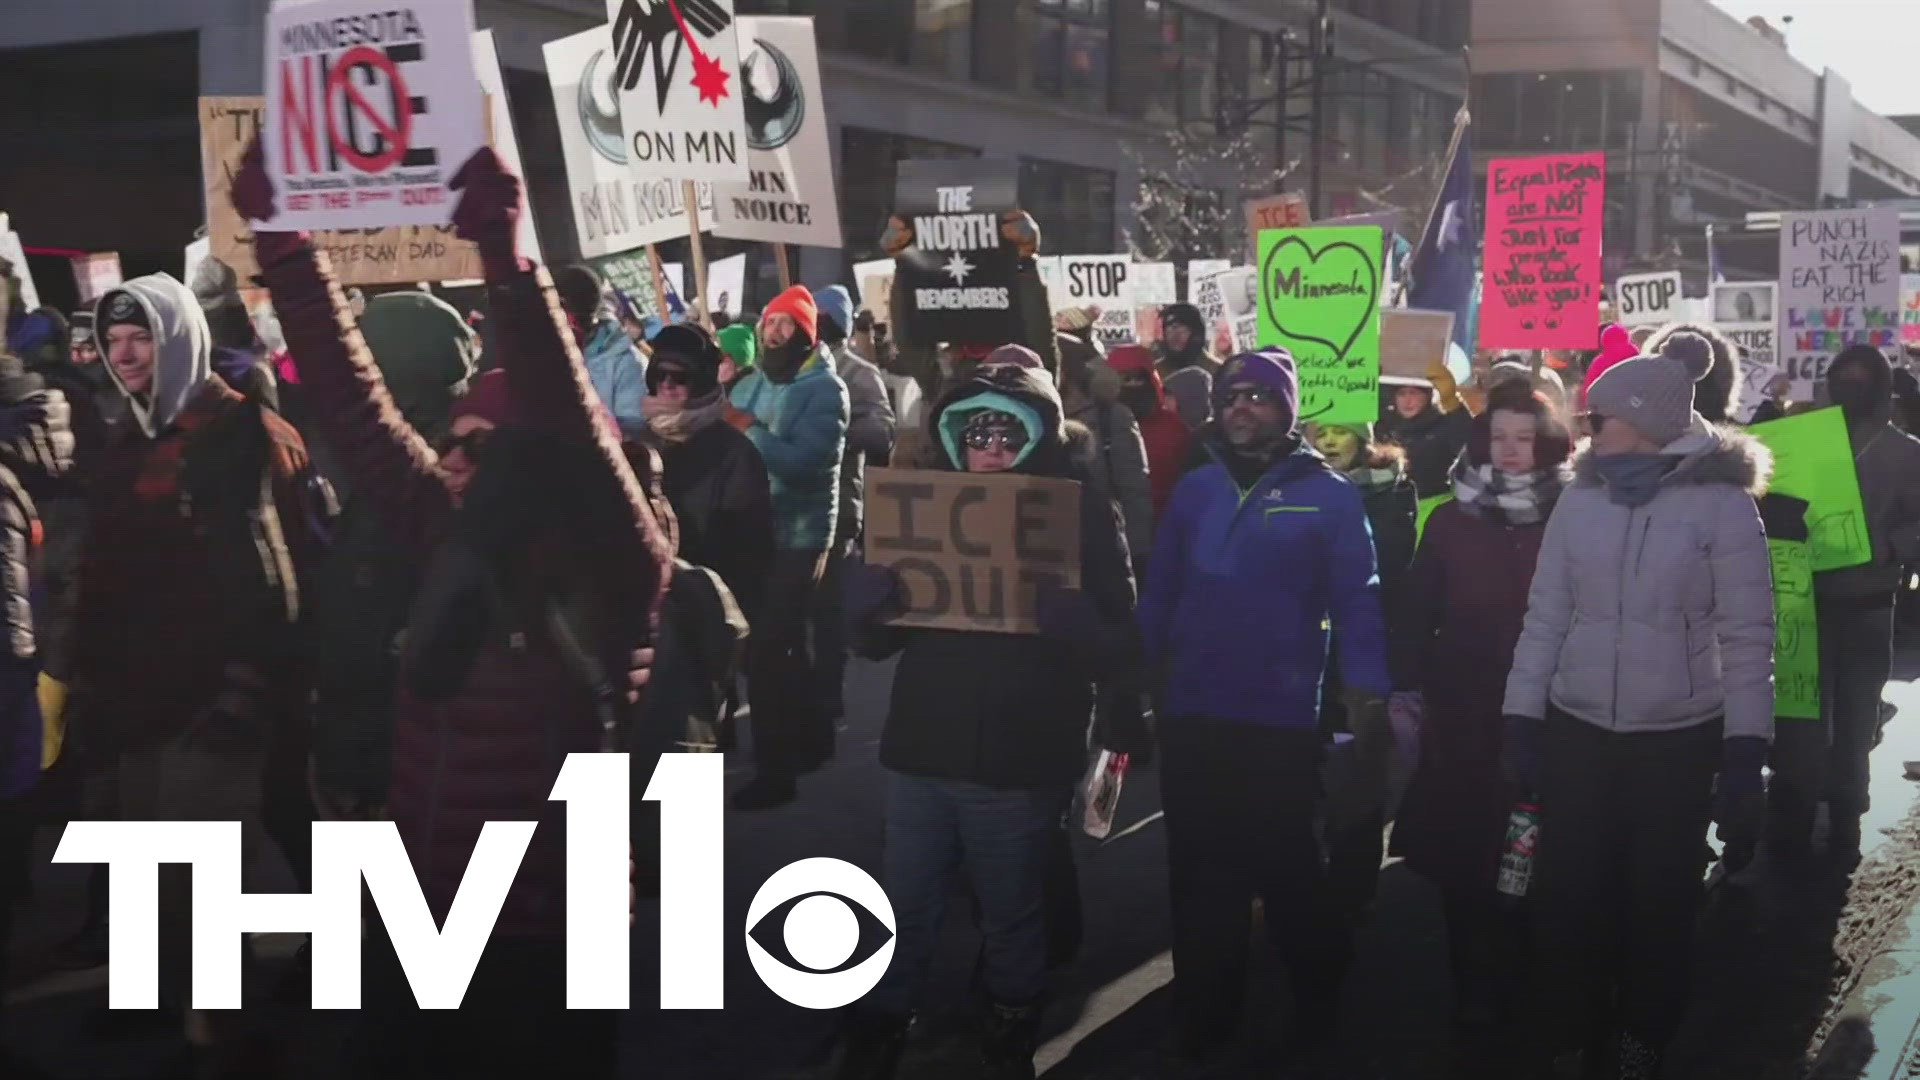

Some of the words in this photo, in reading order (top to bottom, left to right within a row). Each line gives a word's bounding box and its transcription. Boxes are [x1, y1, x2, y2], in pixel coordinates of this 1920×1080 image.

[633, 130, 674, 162] ON
[685, 130, 737, 164] MN
[748, 169, 786, 194] MN
[1494, 162, 1555, 202] Equal
[579, 180, 630, 241] MN
[632, 176, 713, 227] NOIE
[732, 196, 812, 226] NOICE
[936, 185, 973, 212] THE
[1506, 202, 1537, 217] are
[1545, 190, 1588, 215] NOT
[1257, 202, 1299, 228] ICE
[913, 213, 999, 251] NORTH
[1792, 217, 1867, 248] PUNCH
[322, 243, 398, 264] ETERAN
[409, 242, 447, 260] DAD
[1509, 247, 1568, 274] people
[1820, 240, 1891, 264] NAZIS
[1068, 261, 1127, 298] STOP
[1273, 265, 1368, 300] Minnesota
[1791, 267, 1828, 289] EAT
[1845, 261, 1888, 285] THE
[915, 286, 1010, 311] REMEMBERS
[1621, 278, 1676, 314] STOP
[1822, 285, 1866, 305] RICH
[1787, 304, 1856, 330] LOVE
[1787, 355, 1830, 381] ICE
[873, 481, 1067, 563] ICE
